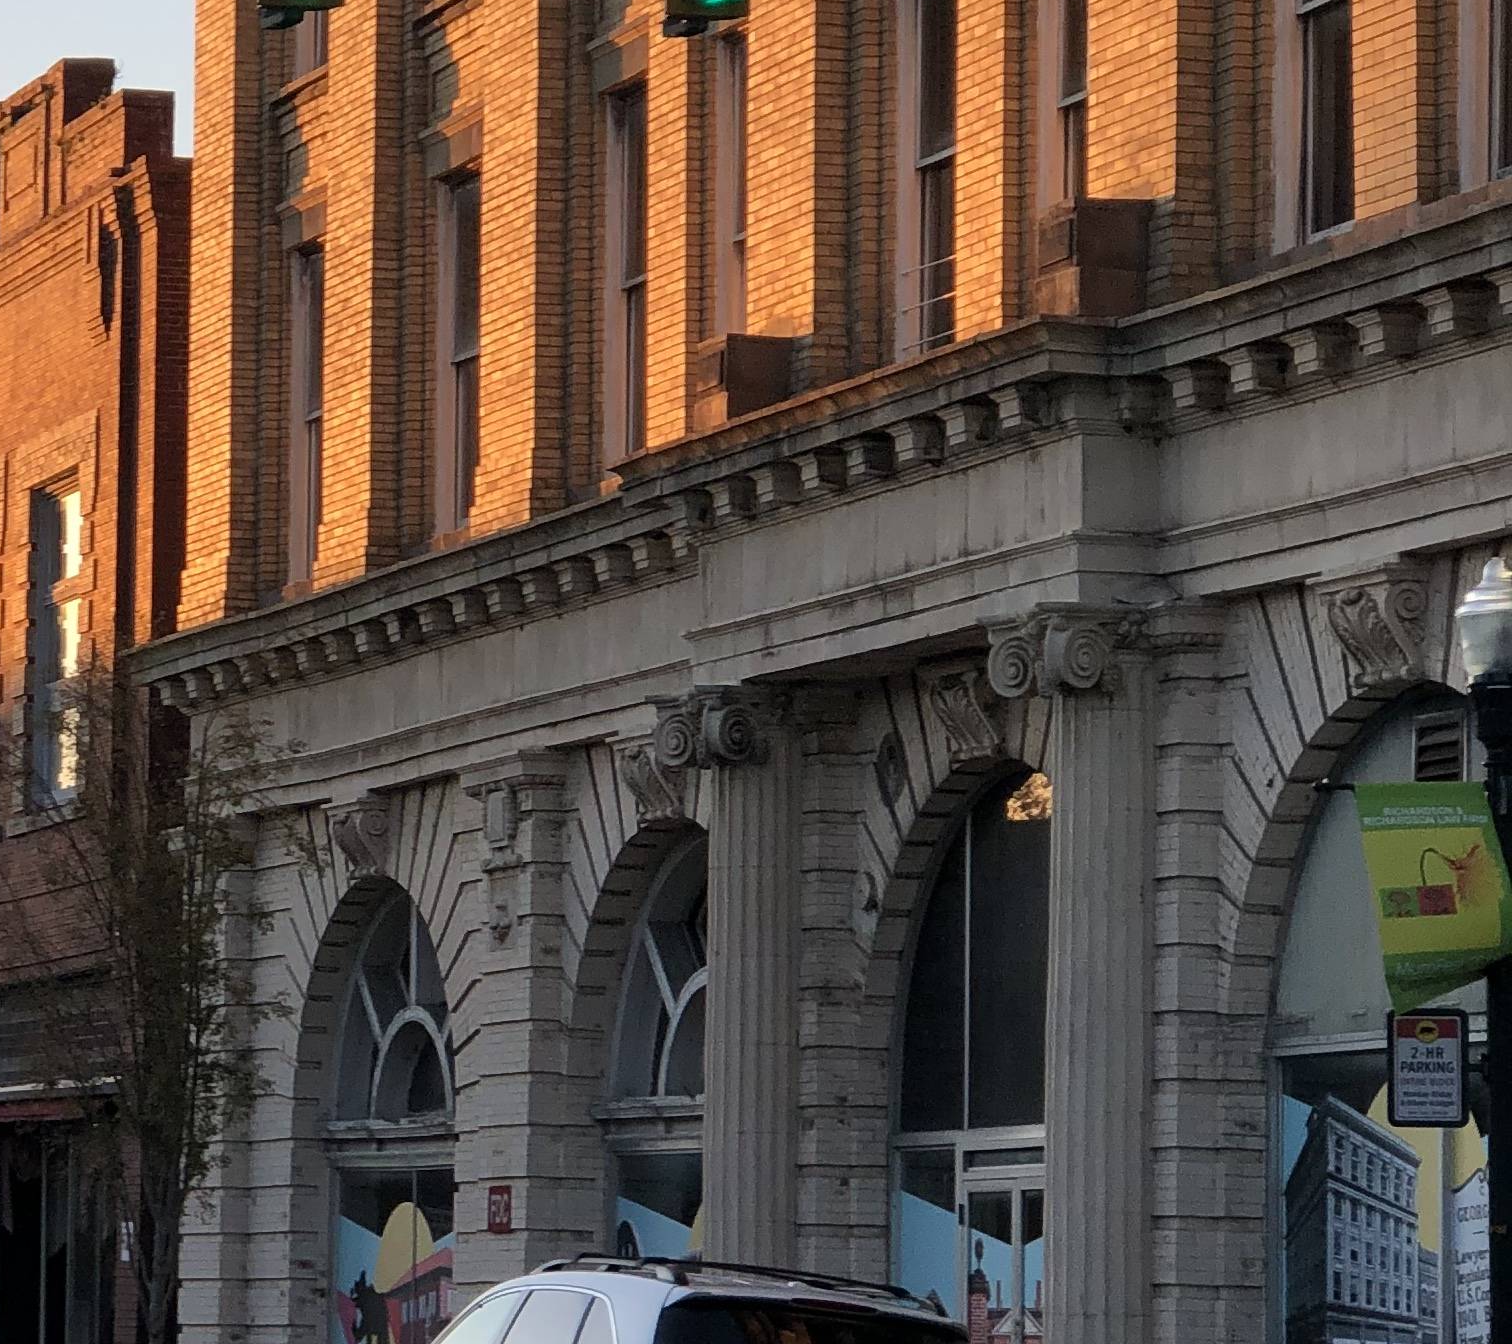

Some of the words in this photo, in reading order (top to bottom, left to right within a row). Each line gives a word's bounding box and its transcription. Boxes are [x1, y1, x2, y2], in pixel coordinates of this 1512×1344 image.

[1410, 1047, 1445, 1060] 2-HR
[1400, 1061, 1456, 1074] PARKING
[490, 1193, 508, 1224] FDC
